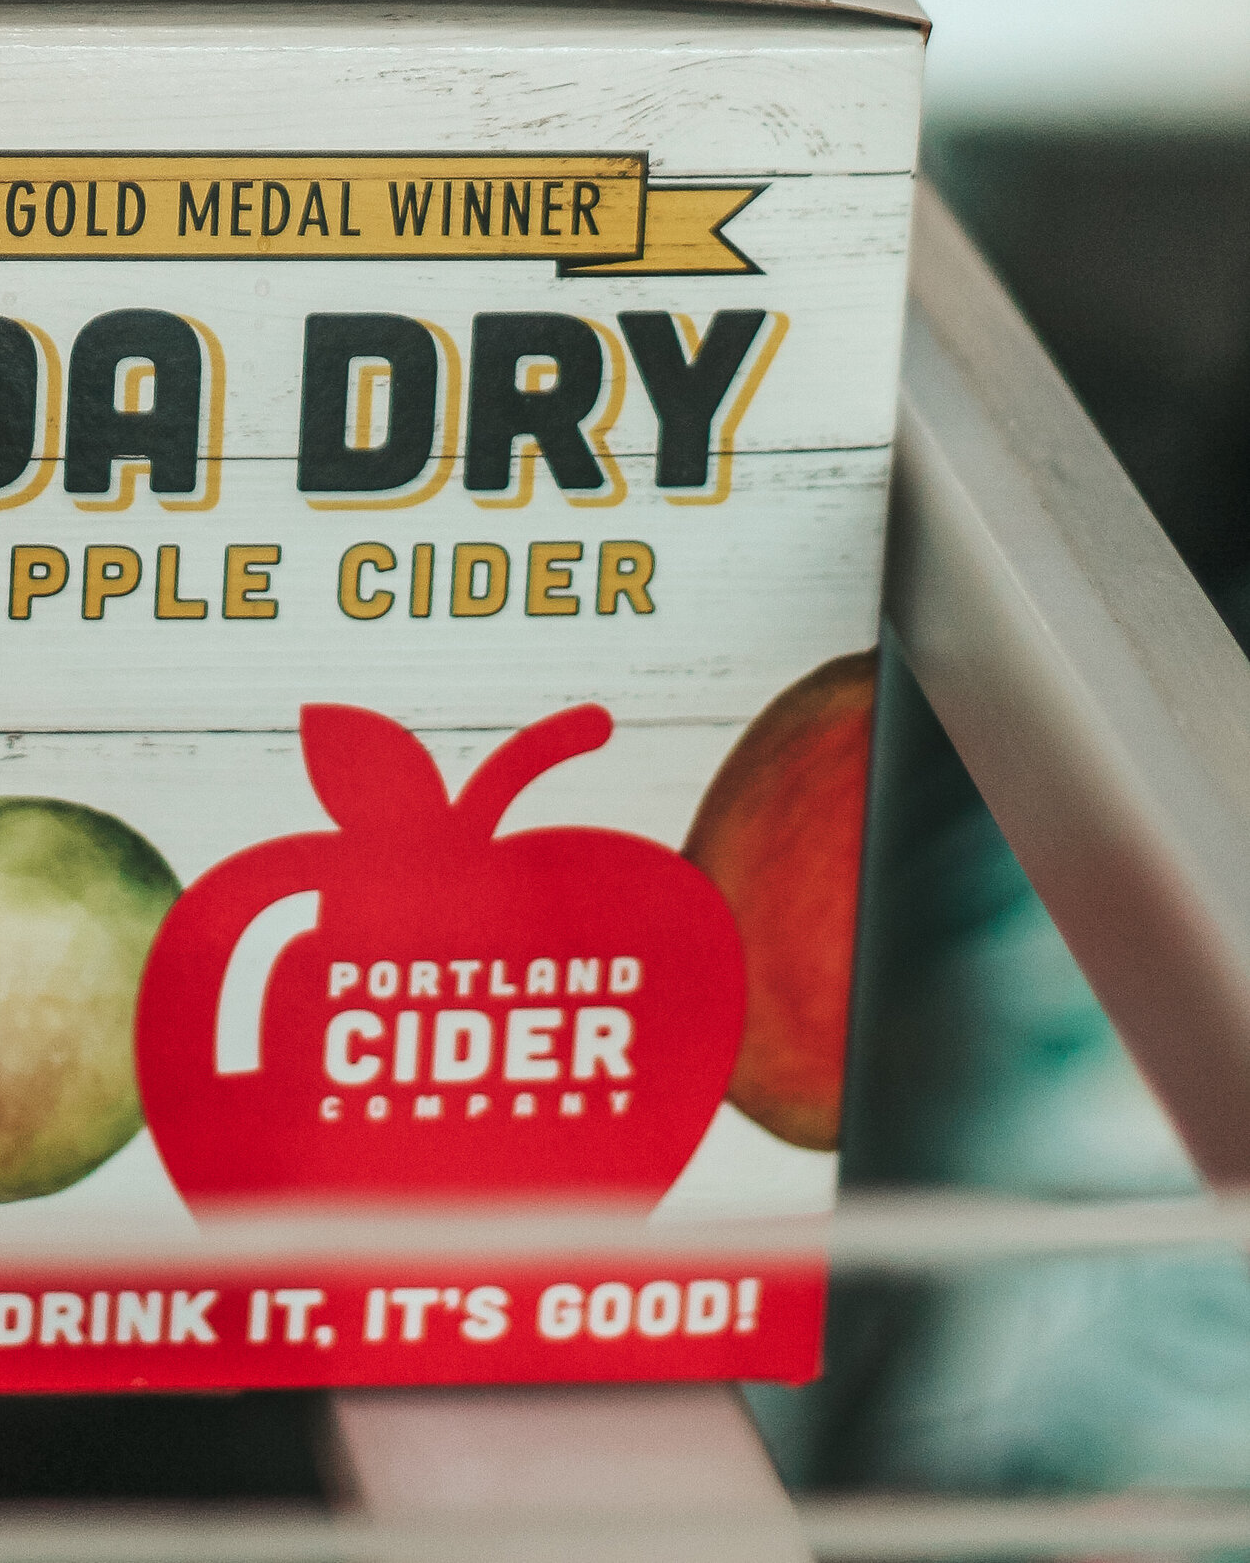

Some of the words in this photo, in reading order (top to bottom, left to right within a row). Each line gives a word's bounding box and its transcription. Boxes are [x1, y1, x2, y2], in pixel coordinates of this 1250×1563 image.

[5, 180, 146, 237] GOLD
[177, 180, 362, 237] MEDAL
[388, 179, 602, 237] WINNER
[296, 308, 790, 511] DRY
[337, 540, 656, 620] CIDER
[327, 956, 641, 1000] PORTLAND
[323, 1005, 635, 1086] CIDER
[319, 1090, 632, 1121] COMPANY
[247, 1288, 335, 1349] IT,
[365, 1286, 510, 1342] IT'S
[538, 1277, 762, 1340] GOOD!
